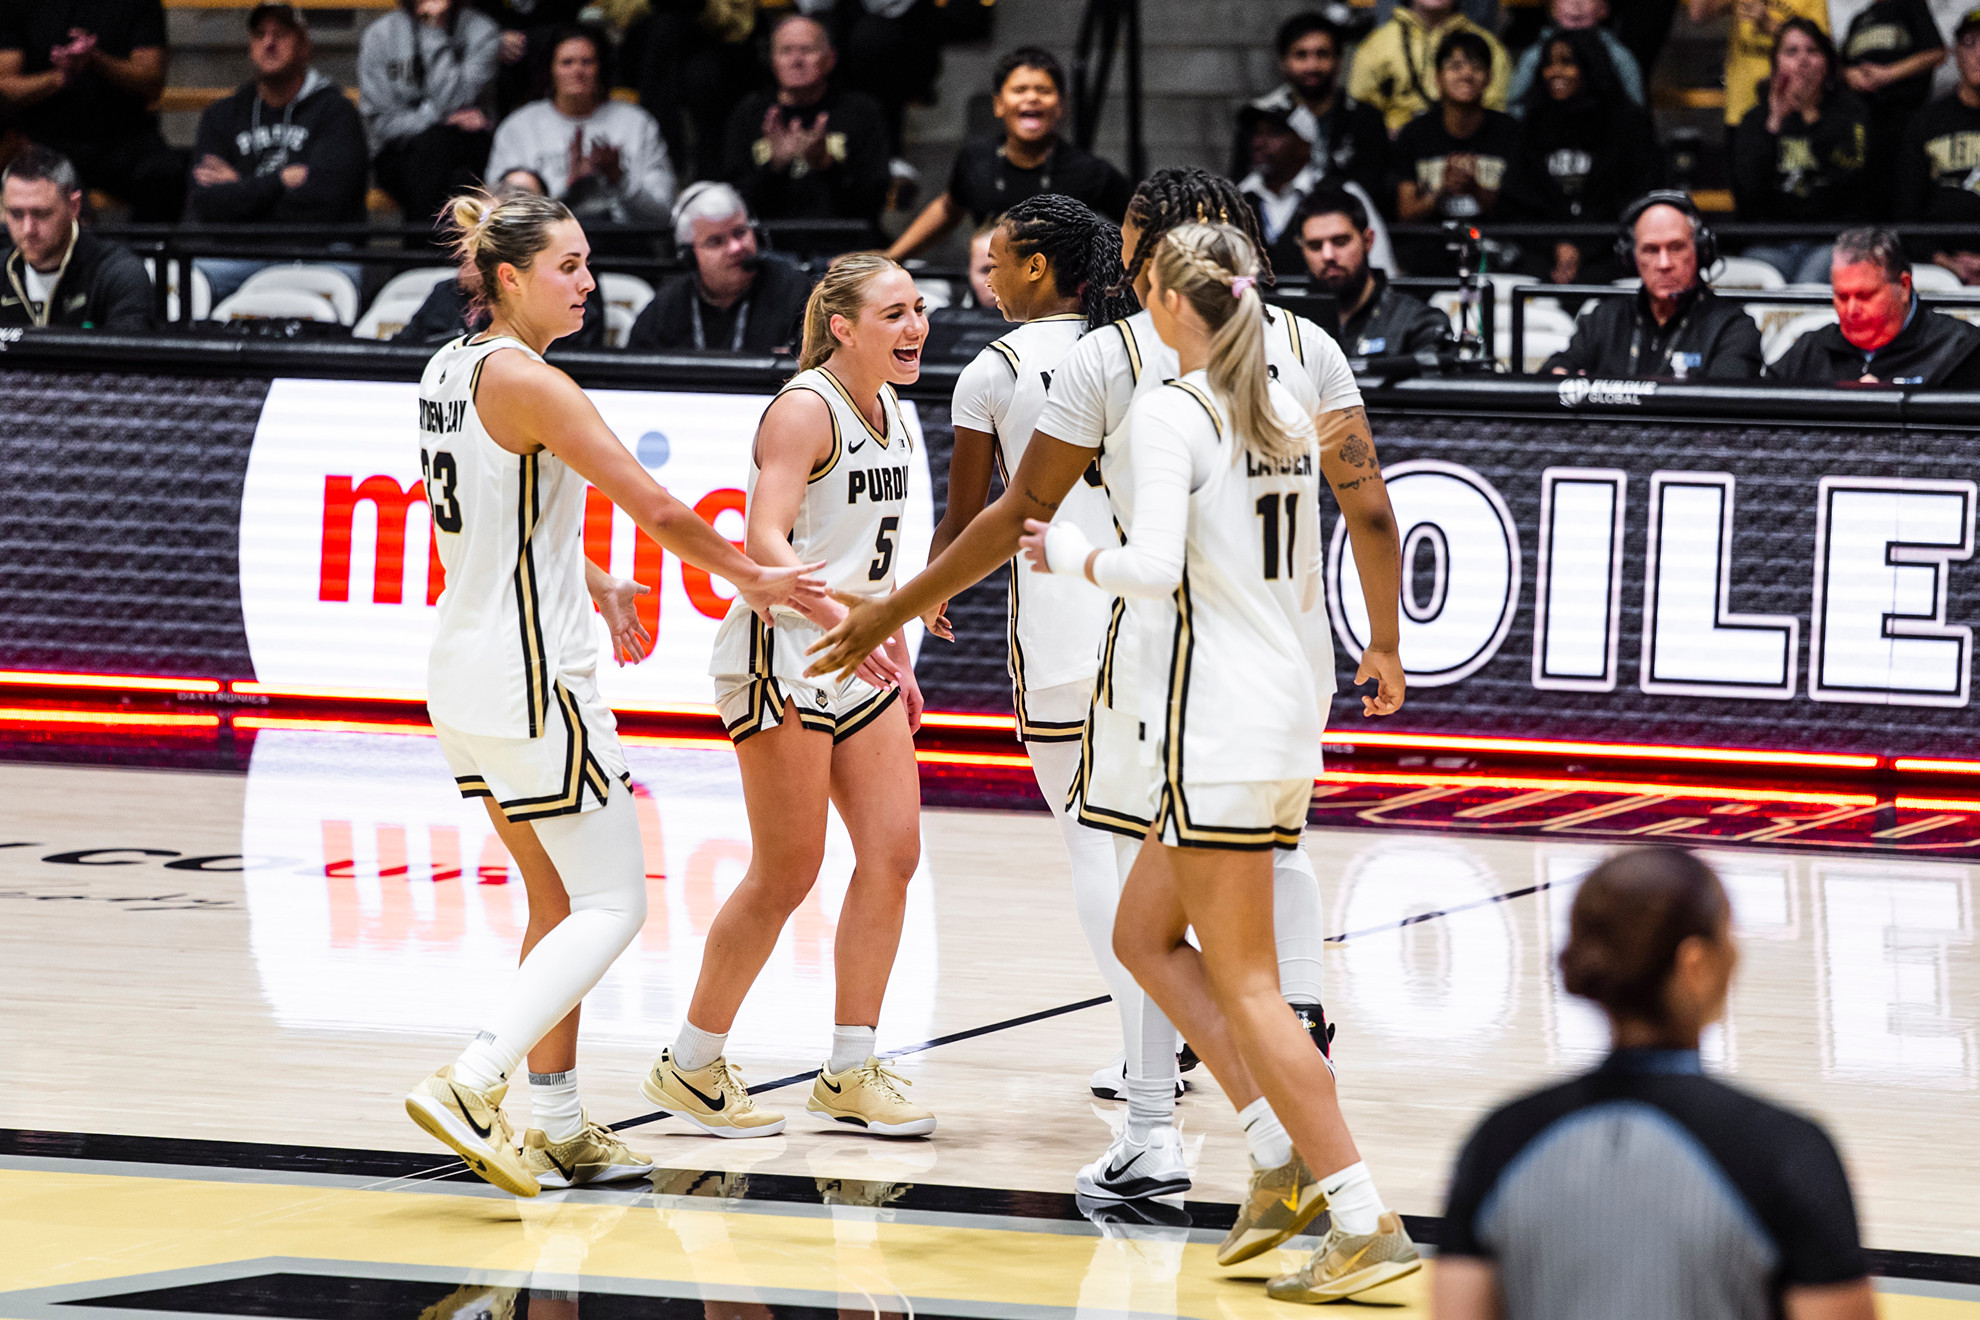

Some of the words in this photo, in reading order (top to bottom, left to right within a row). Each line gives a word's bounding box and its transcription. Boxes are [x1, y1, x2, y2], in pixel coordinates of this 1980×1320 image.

[847, 465, 909, 505] PURDU
[868, 516, 900, 581] 5
[1255, 492, 1299, 581] 11
[1327, 458, 1978, 708] OILE
